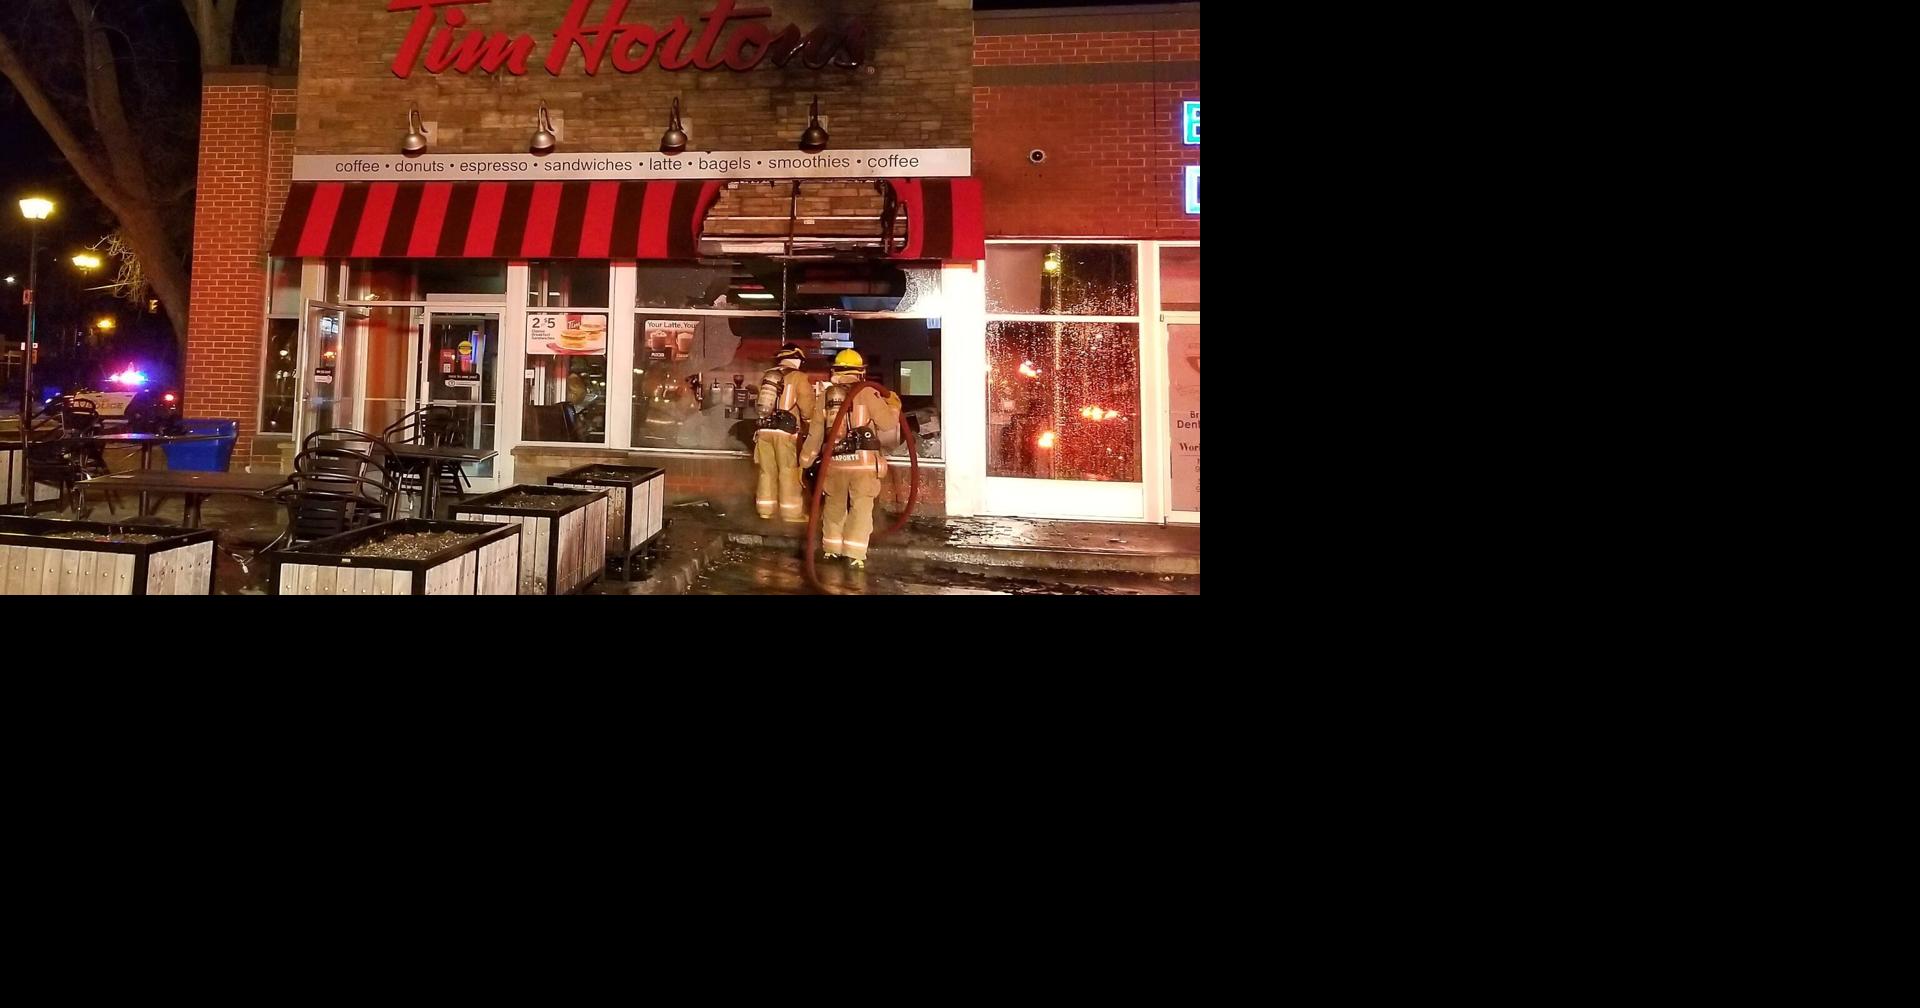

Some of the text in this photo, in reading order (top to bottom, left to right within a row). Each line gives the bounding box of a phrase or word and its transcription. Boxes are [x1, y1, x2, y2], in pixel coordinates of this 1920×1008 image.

[387, 0, 865, 79] Tim Hortons
[335, 153, 920, 175] coffee donuts espresso sandwiches latte bagels smoothies coffee
